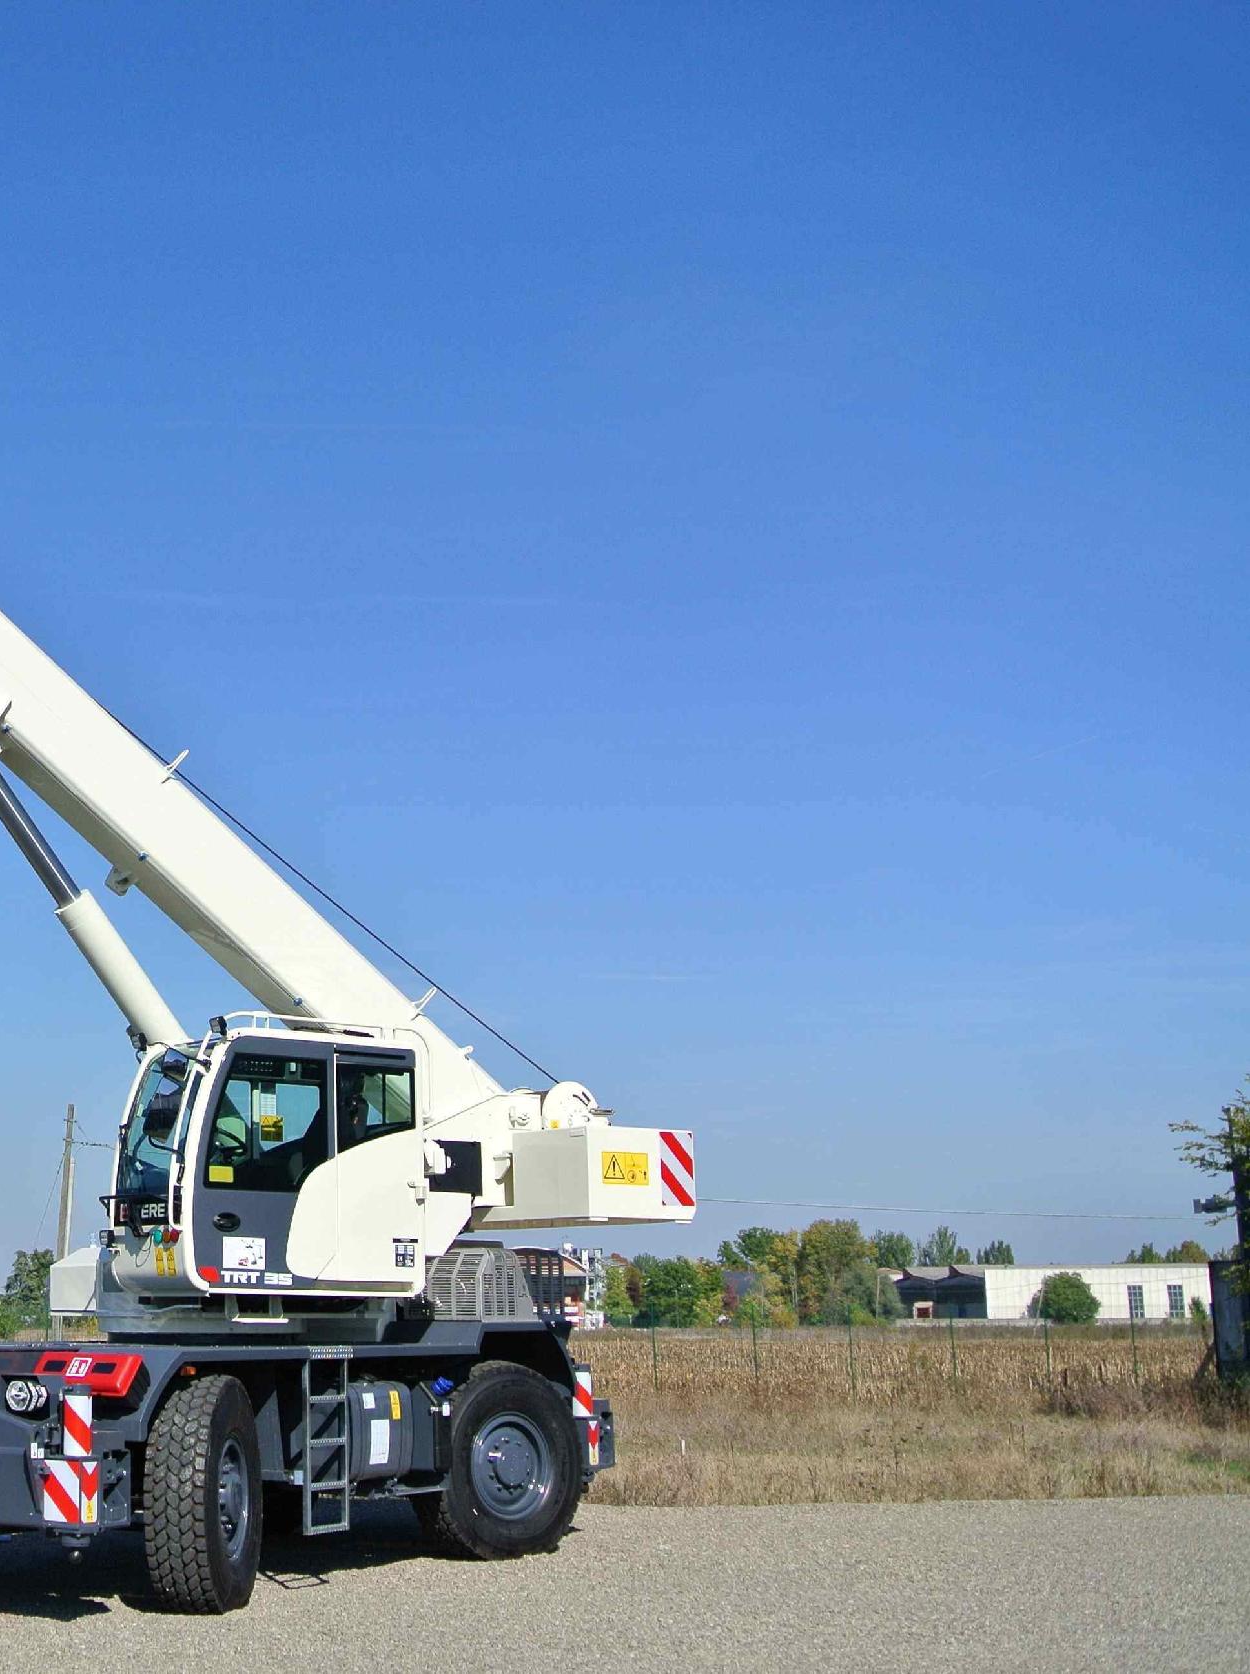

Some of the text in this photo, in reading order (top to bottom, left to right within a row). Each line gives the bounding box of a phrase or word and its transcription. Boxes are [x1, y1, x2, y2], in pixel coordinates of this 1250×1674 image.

[140, 1203, 167, 1219] ERE
[221, 1271, 293, 1286] TRT 35
